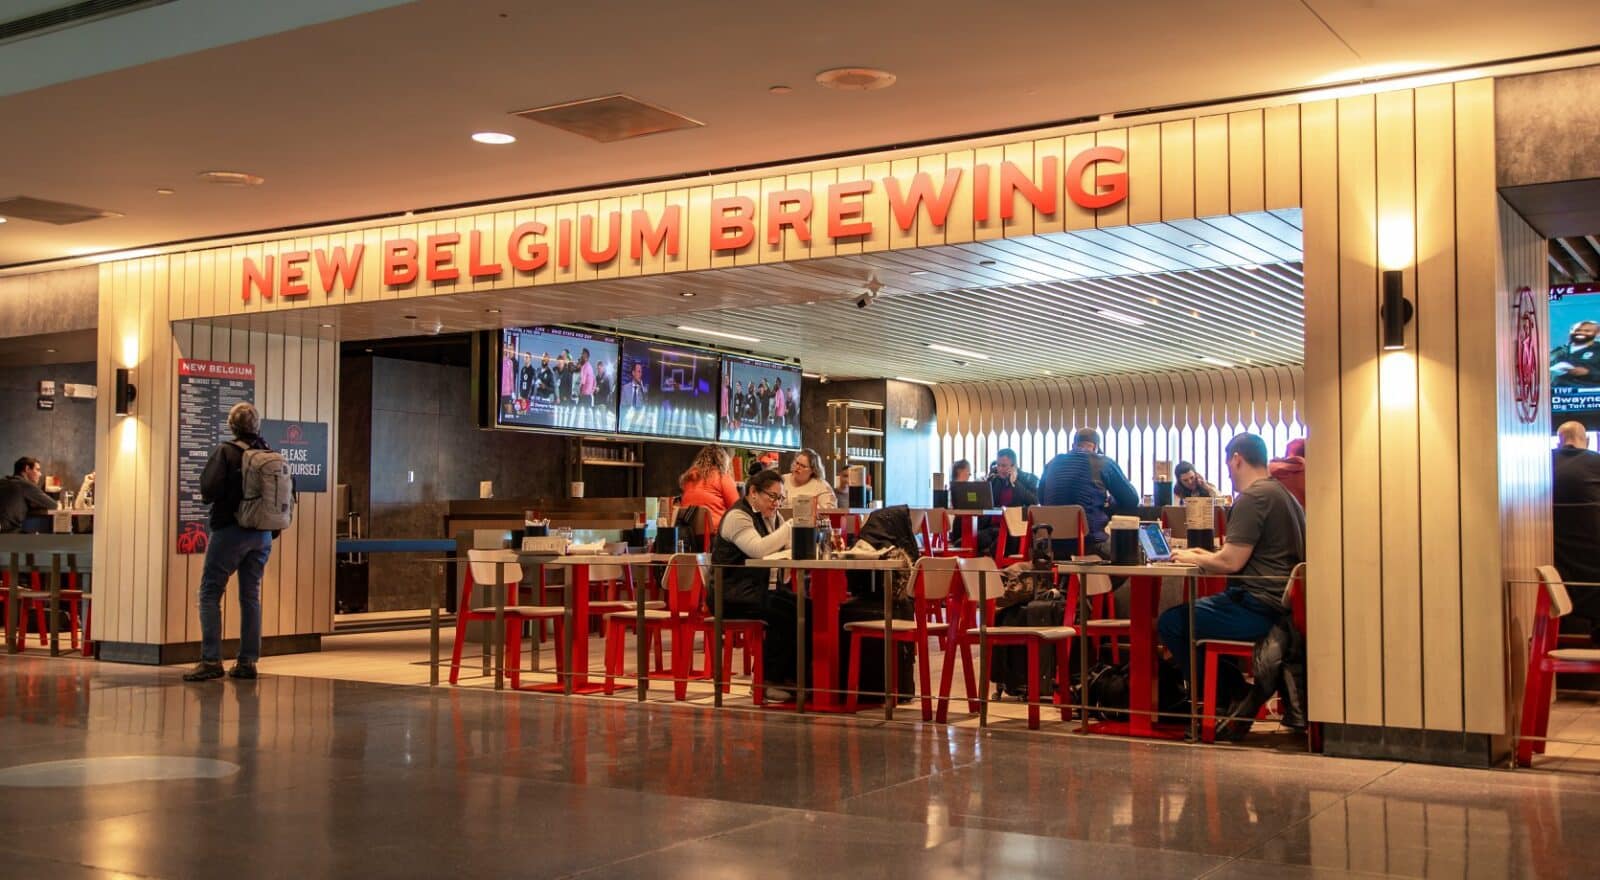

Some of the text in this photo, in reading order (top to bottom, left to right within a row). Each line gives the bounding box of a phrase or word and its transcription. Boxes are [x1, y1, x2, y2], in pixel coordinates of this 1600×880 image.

[241, 145, 1131, 303] NEW BELGIUM BREWING
[1550, 287, 1575, 295] IVE
[182, 361, 253, 376] NEW BELGIUM
[281, 448, 308, 461] PLEASE
[290, 463, 322, 476] OURSELF
